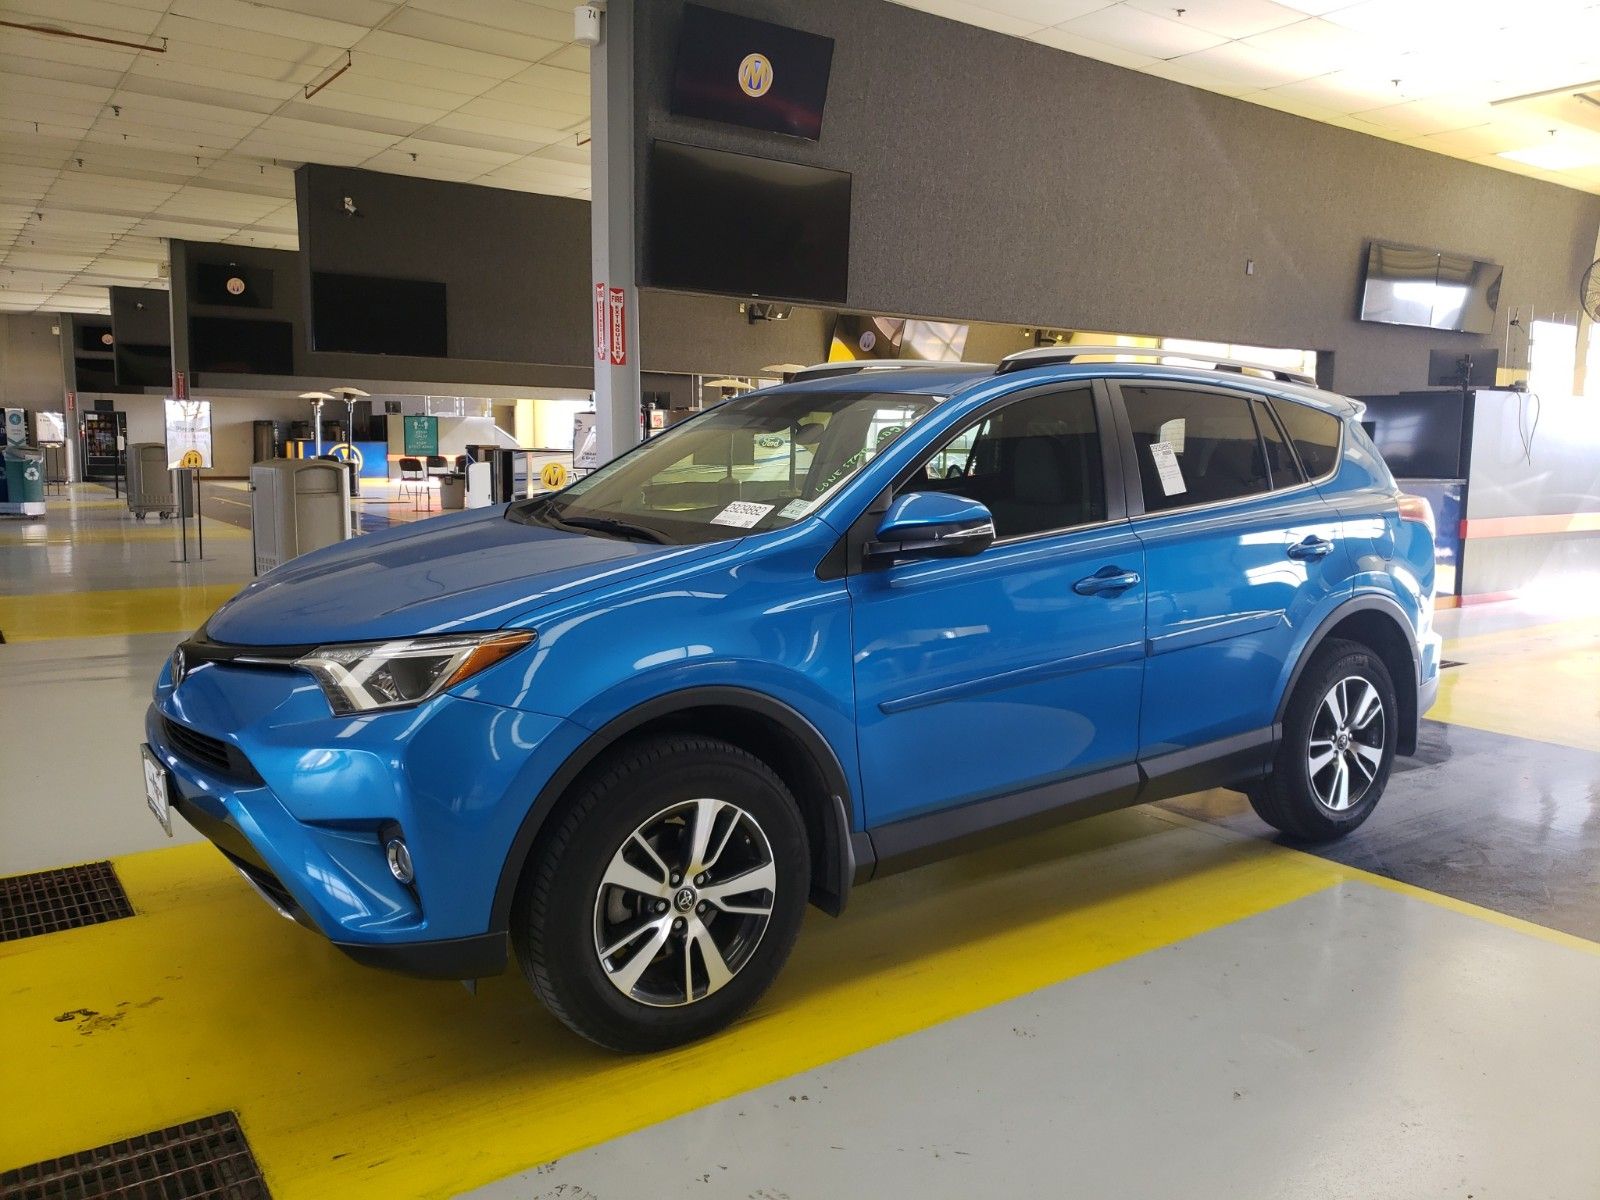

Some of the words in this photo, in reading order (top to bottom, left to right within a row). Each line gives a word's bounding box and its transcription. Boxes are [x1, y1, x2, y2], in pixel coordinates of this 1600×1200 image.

[611, 295, 622, 303] FIRE
[761, 436, 780, 447] Ford
[815, 469, 842, 493] LONE
